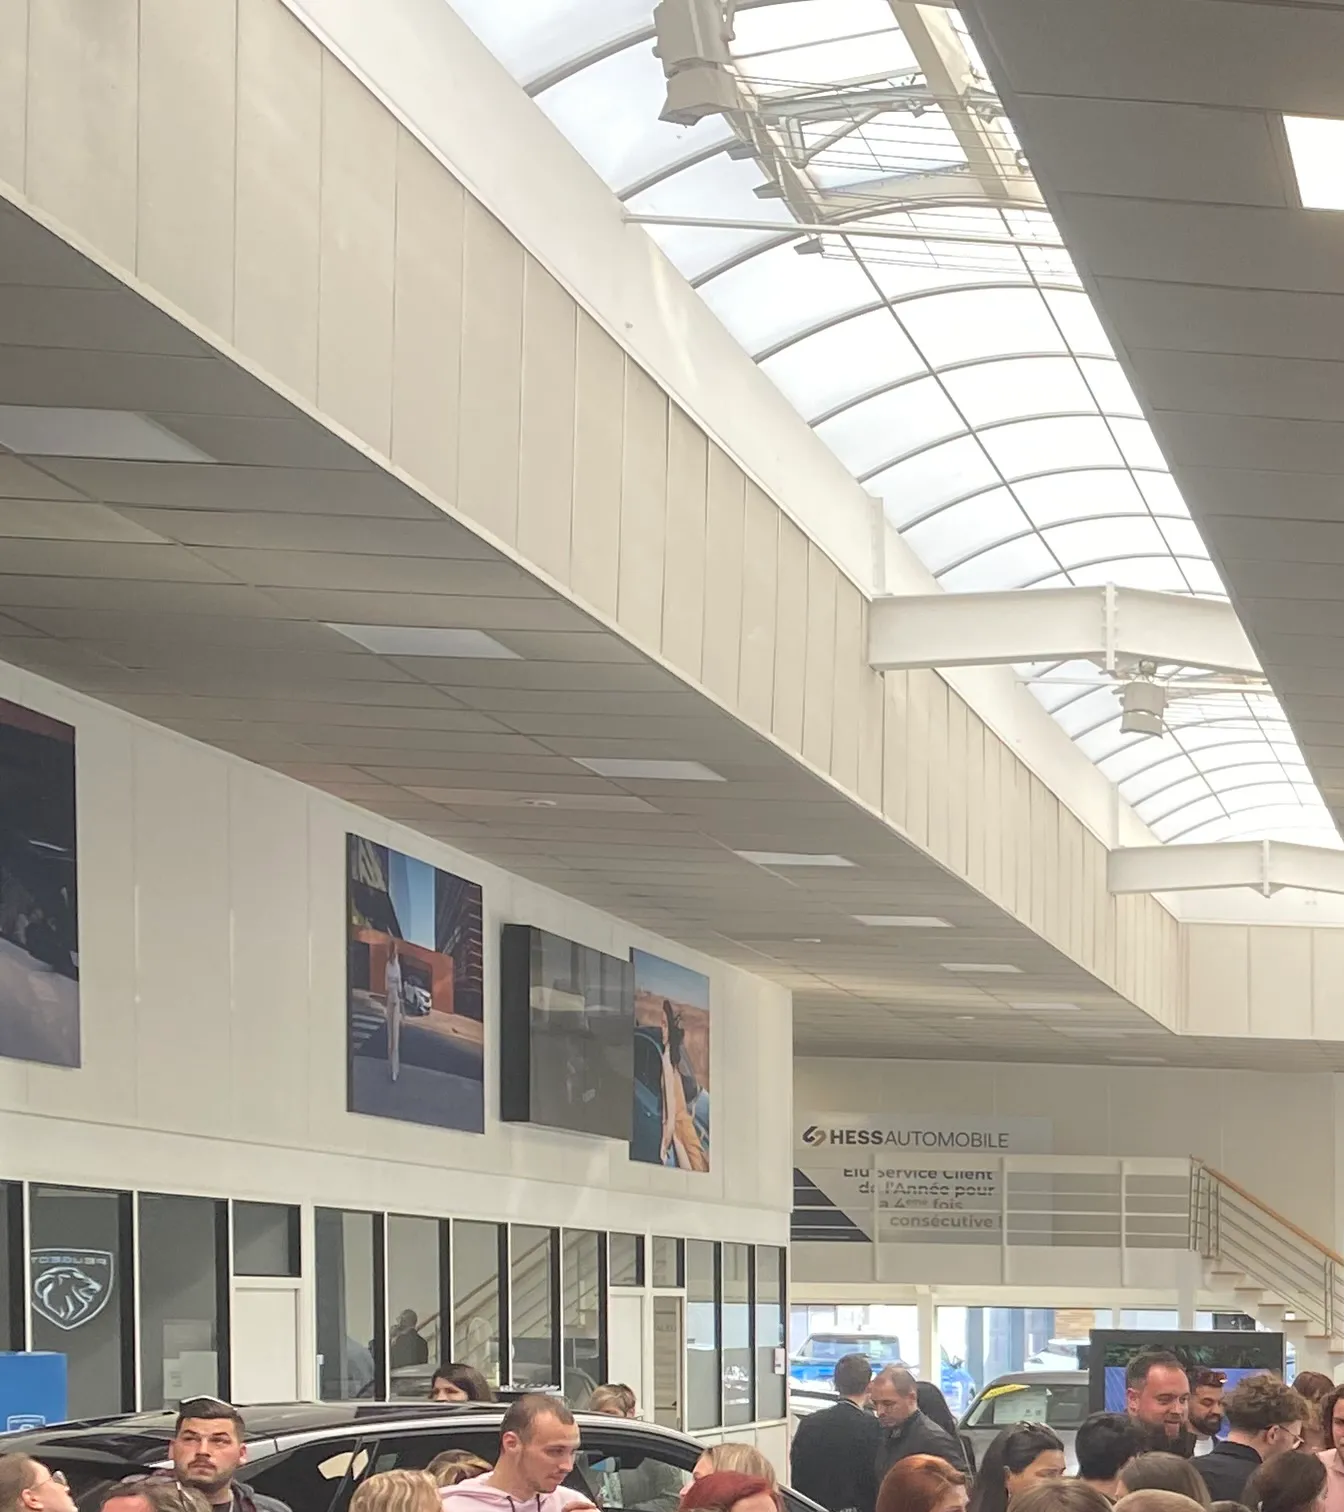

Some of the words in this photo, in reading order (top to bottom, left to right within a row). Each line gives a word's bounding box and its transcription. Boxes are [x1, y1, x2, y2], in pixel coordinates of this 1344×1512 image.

[877, 1168, 938, 1180] Service
[942, 1170, 993, 1180] Client
[954, 1185, 996, 1198] pour
[932, 1198, 964, 1209] fois
[889, 1214, 993, 1228] consécutive
